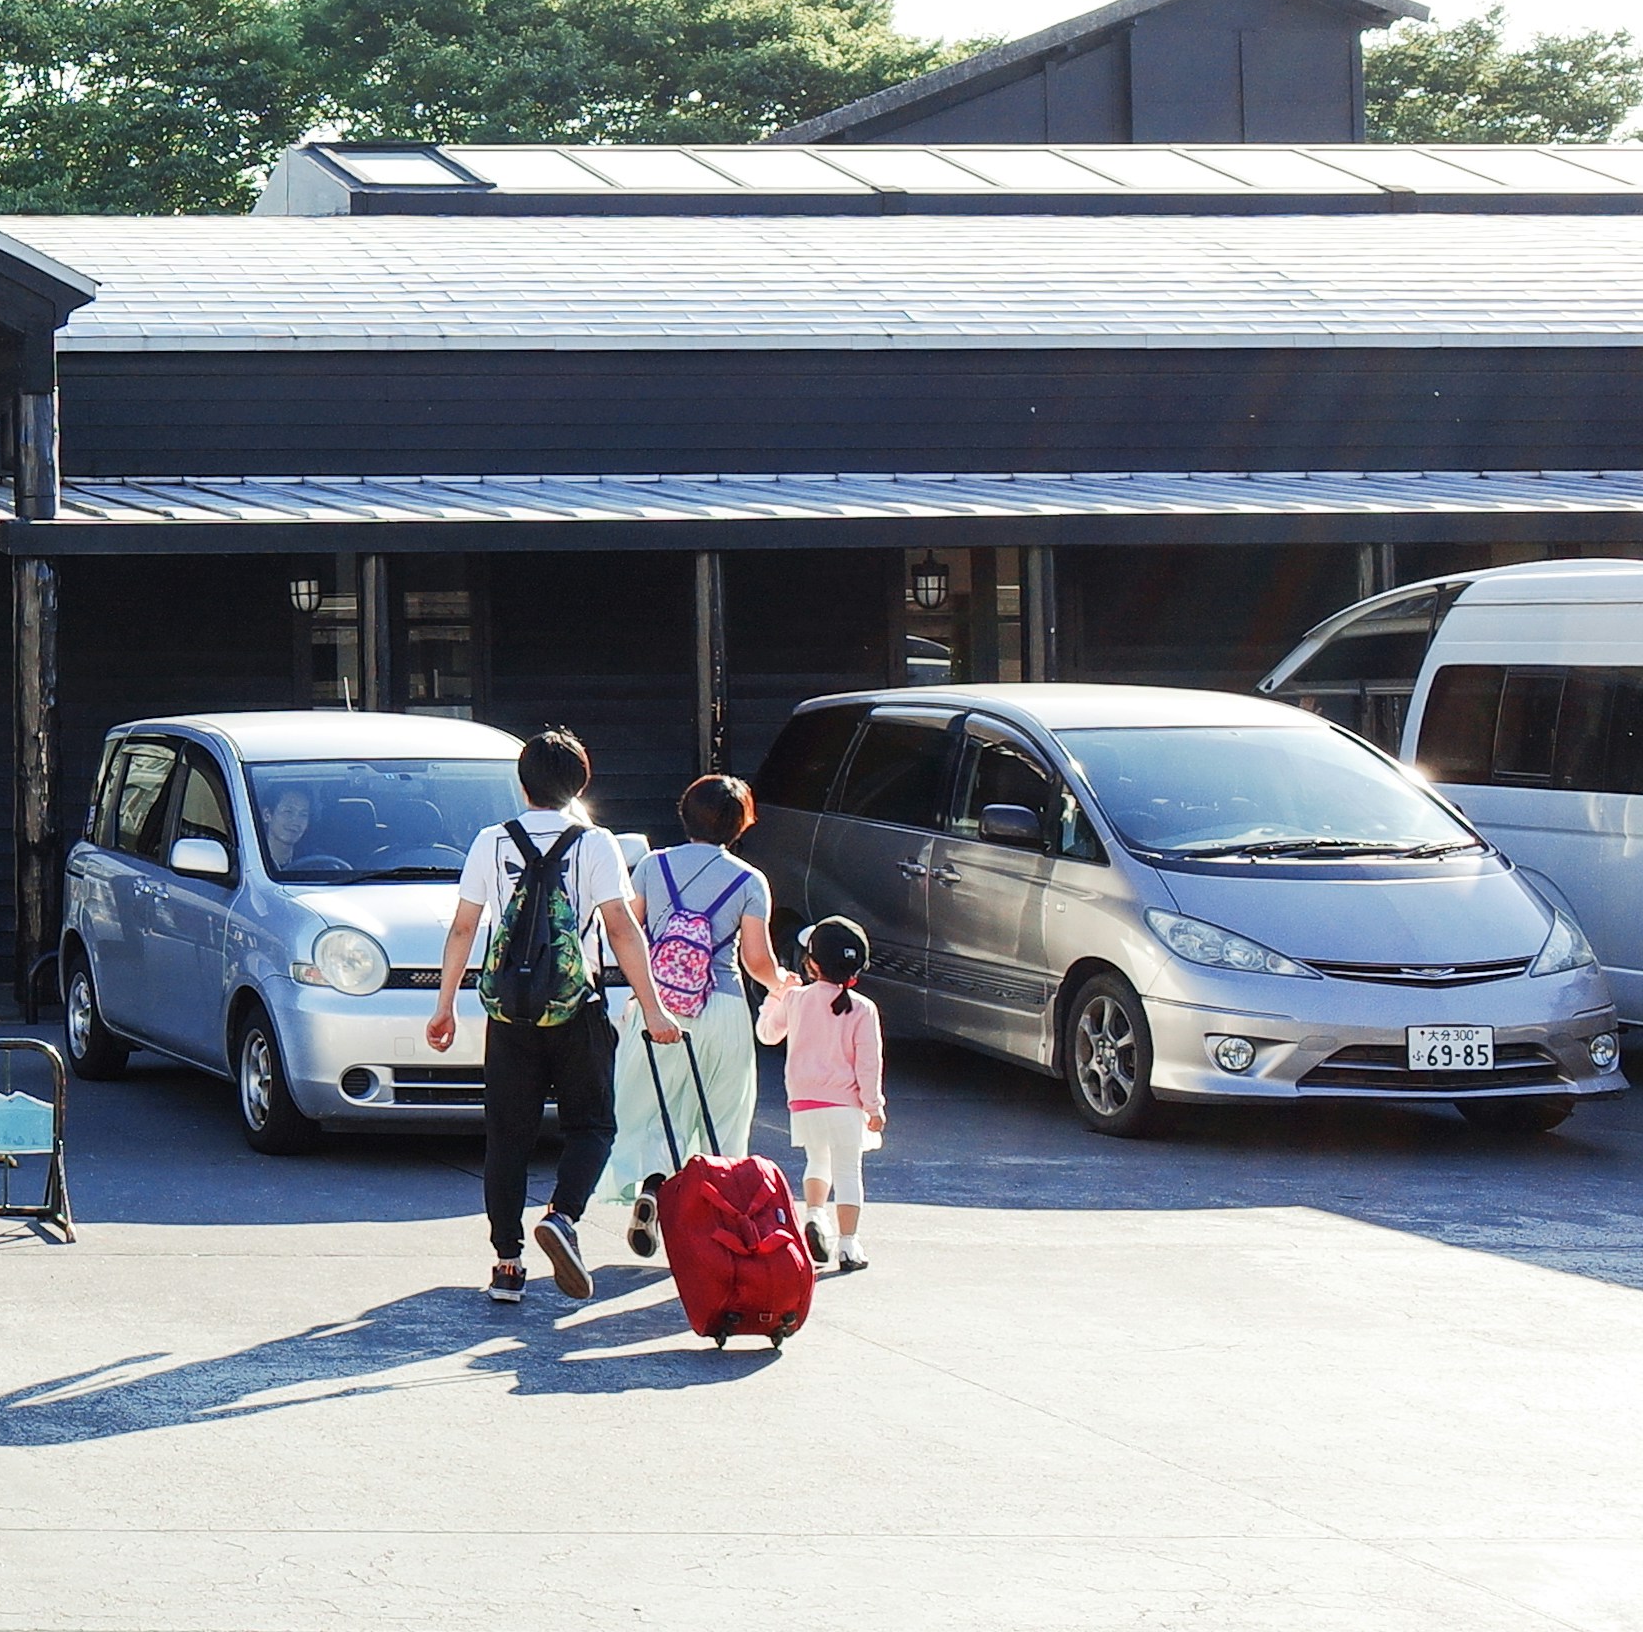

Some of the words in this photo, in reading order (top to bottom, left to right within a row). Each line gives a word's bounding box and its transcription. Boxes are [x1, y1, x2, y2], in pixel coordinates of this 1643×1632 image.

[1428, 1030, 1451, 1042] 大分
[1453, 1030, 1474, 1042] 300
[1413, 1050, 1425, 1062] ふ
[1427, 1044, 1489, 1067] 69-85
